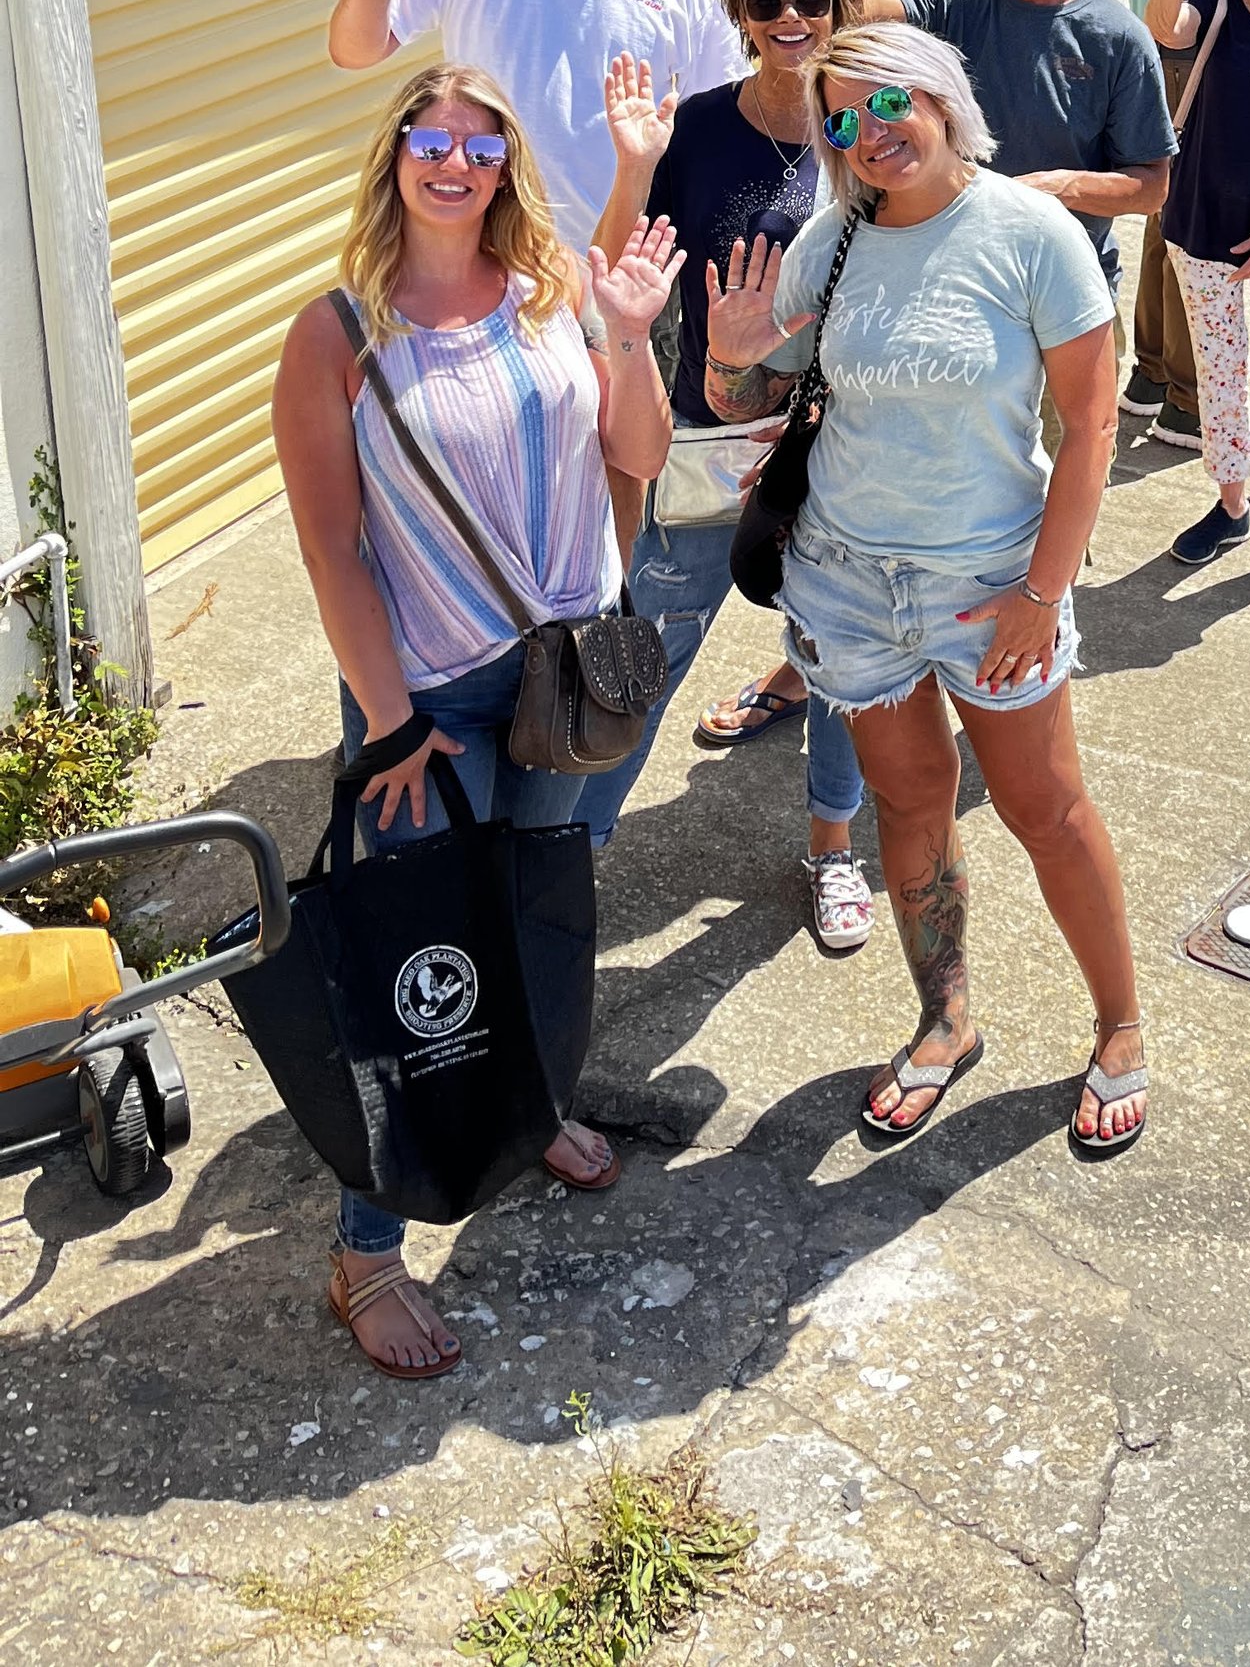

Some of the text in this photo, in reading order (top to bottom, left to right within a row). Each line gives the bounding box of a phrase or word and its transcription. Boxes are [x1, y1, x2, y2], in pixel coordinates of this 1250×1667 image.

[826, 340, 984, 406] mperfect
[404, 969, 415, 986] RED
[413, 955, 430, 969] OAK
[431, 953, 472, 982] PLANTATION
